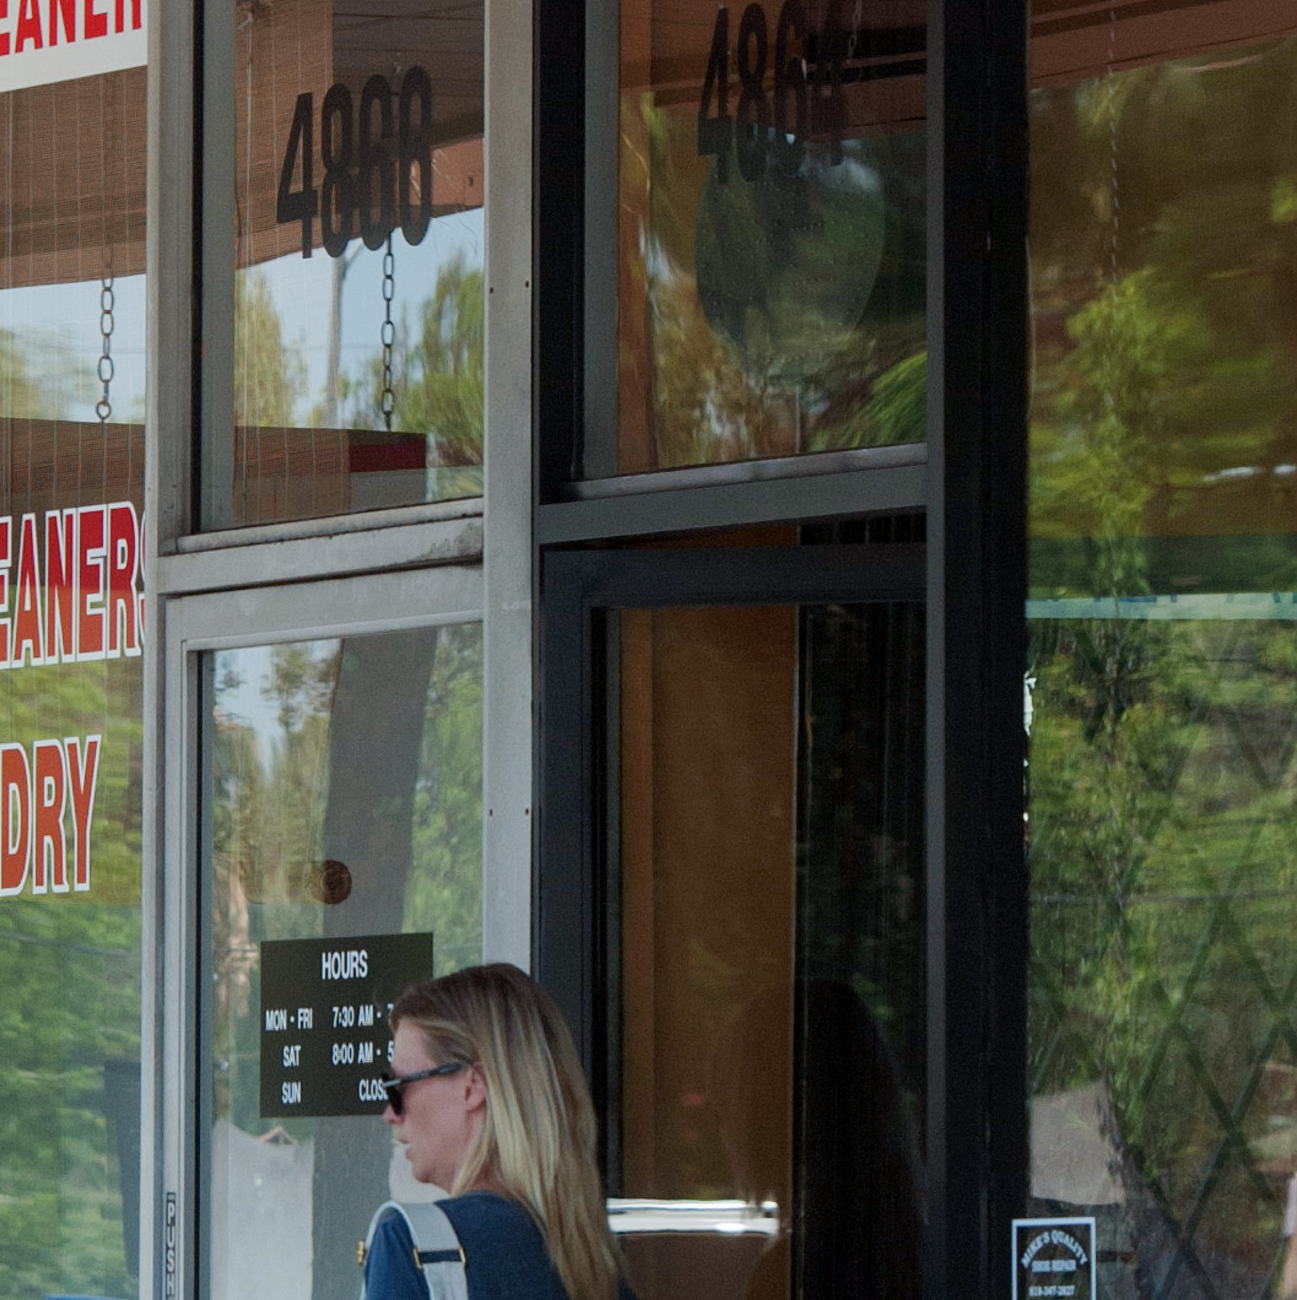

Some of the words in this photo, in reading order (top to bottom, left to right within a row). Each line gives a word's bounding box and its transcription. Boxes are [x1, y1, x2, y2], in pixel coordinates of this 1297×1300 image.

[321, 950, 368, 980] HOURS
[265, 1010, 287, 1031] MON
[297, 1008, 313, 1029] FRI
[332, 1006, 355, 1028] 7:30
[358, 1004, 373, 1026] AM
[283, 1045, 301, 1067] SAT
[332, 1043, 354, 1065] 8:00
[358, 1042, 373, 1064] AM
[281, 1082, 301, 1104] SUN
[166, 1201, 176, 1296] PUSH
